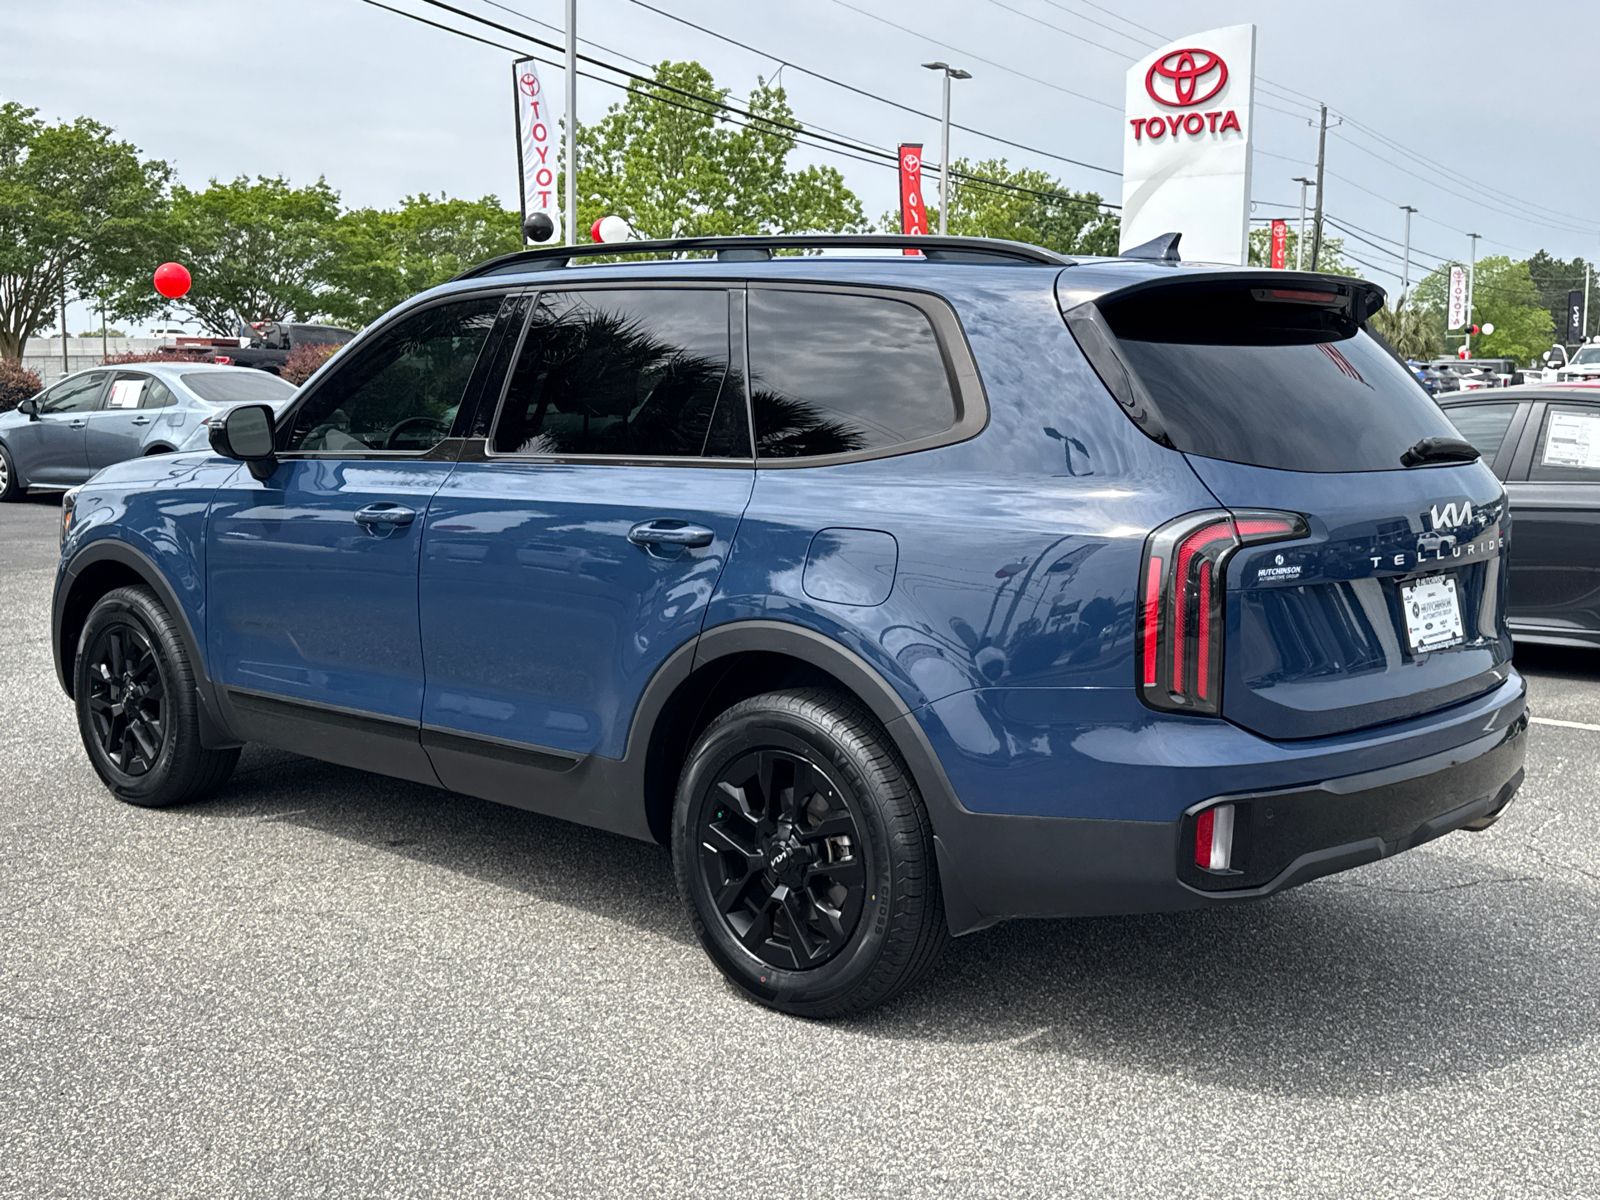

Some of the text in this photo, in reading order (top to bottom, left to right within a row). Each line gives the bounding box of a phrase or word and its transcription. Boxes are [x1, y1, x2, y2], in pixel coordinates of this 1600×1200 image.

[1130, 110, 1240, 140] TOYOTA
[531, 101, 552, 208] TOYOT
[1454, 280, 1462, 325] TOYOTA
[1430, 501, 1473, 530] KIA
[1370, 538, 1505, 569] TELLURIDE
[1257, 566, 1302, 577] HUTCHINSON
[874, 885, 889, 936] CROSS
